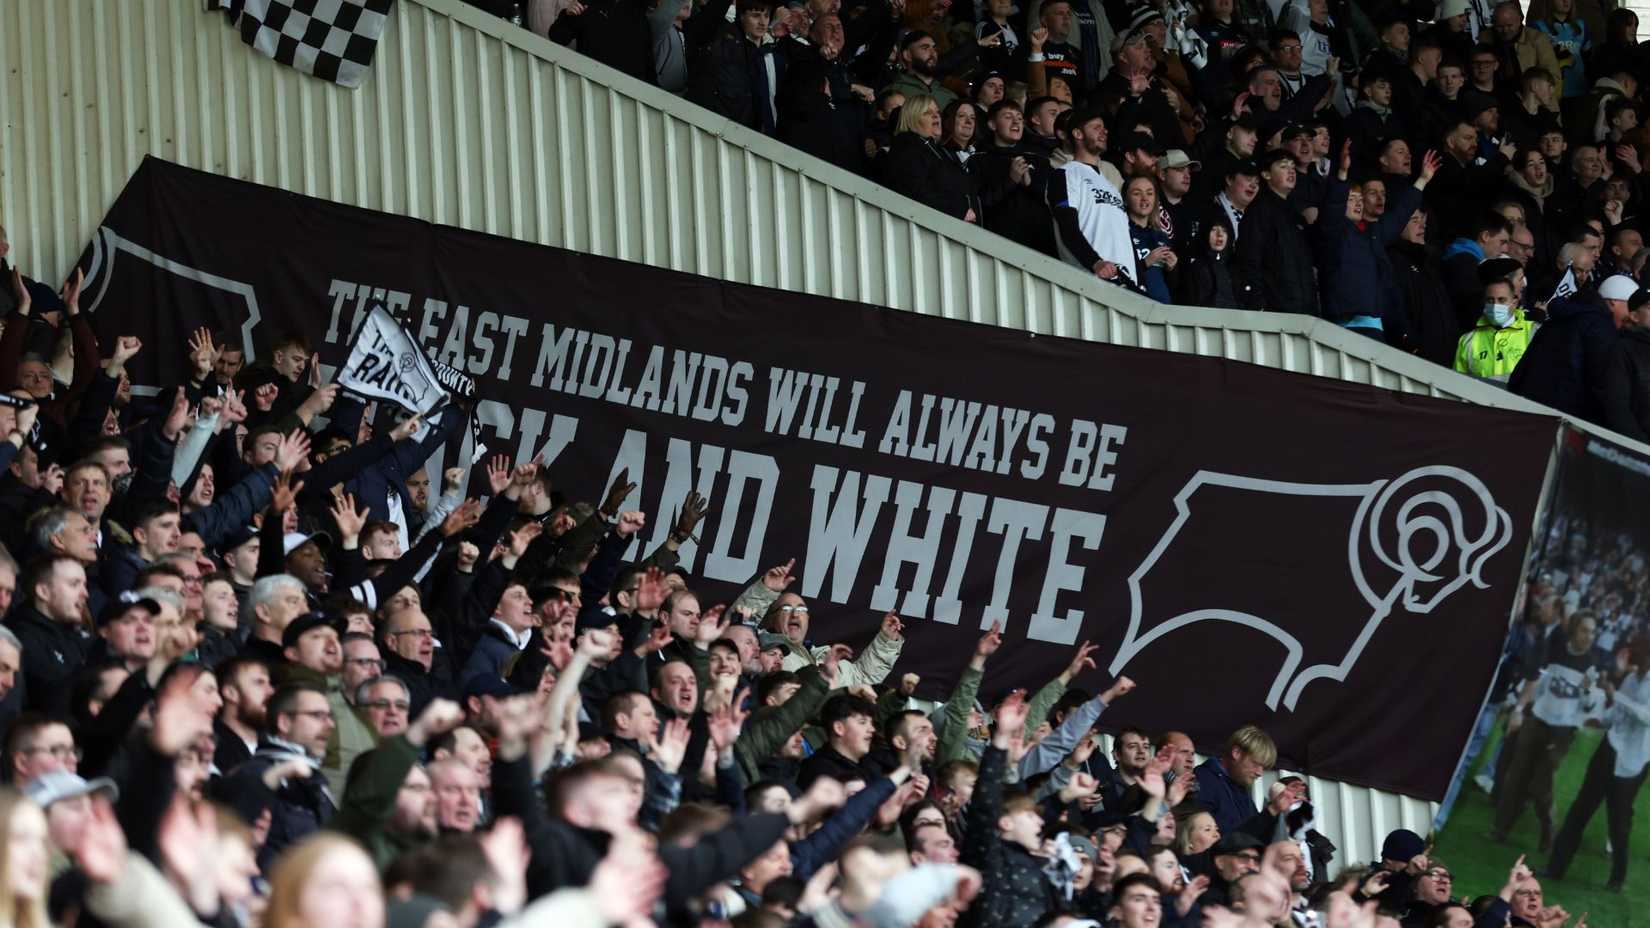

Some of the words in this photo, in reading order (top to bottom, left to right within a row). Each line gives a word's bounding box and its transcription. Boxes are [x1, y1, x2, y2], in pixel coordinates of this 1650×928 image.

[419, 298, 530, 381] EAST
[530, 324, 754, 427] MIDLANDS
[765, 367, 866, 449] WILL
[878, 389, 1056, 480] ALWAYS
[1058, 419, 1128, 492] BE
[597, 428, 781, 585] AND
[800, 463, 1107, 646] WHITE
